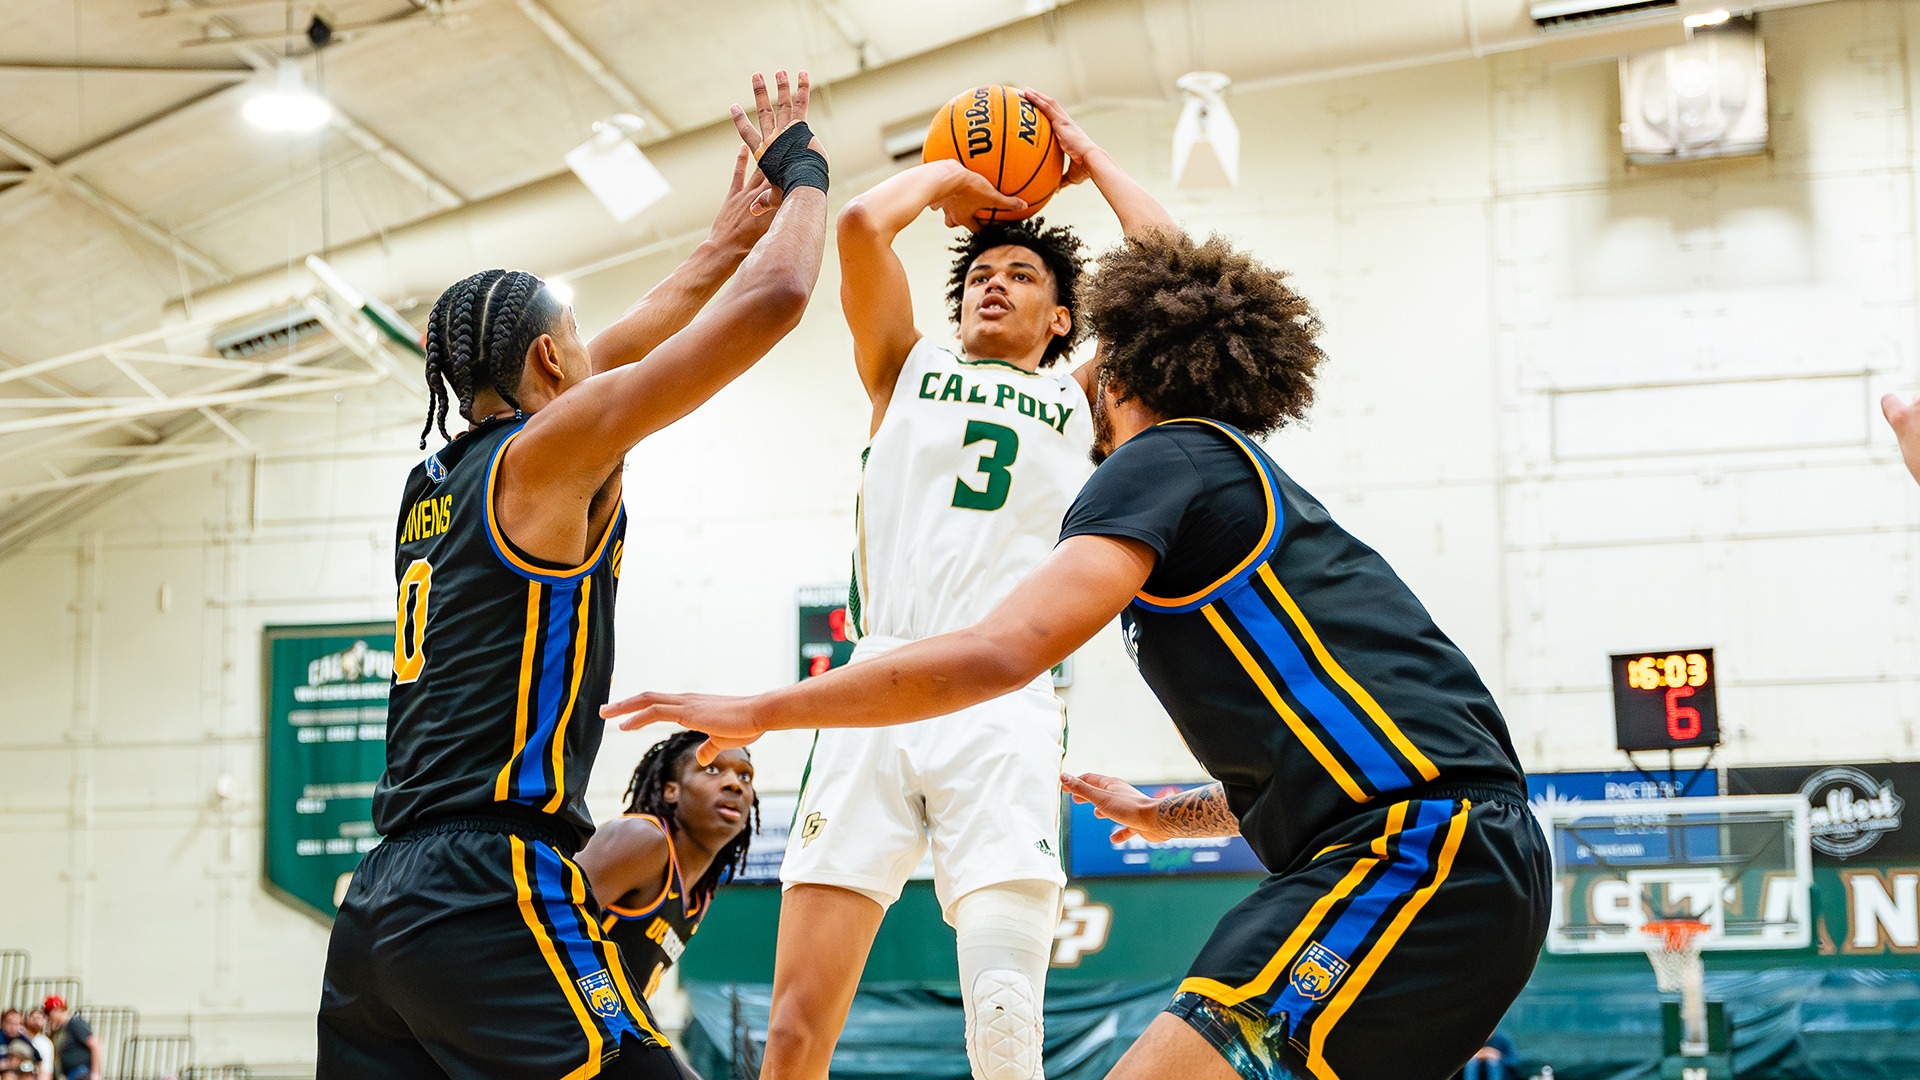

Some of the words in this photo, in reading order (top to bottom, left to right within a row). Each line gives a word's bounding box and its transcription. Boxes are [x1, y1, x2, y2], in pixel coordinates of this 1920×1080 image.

[1017, 91, 1038, 146] NCA
[919, 372, 987, 404] CAL
[993, 383, 1074, 435] POLY
[951, 419, 1019, 512] 3
[393, 556, 434, 685] 0
[1628, 653, 1708, 690] 16:03
[1665, 686, 1702, 740] 6
